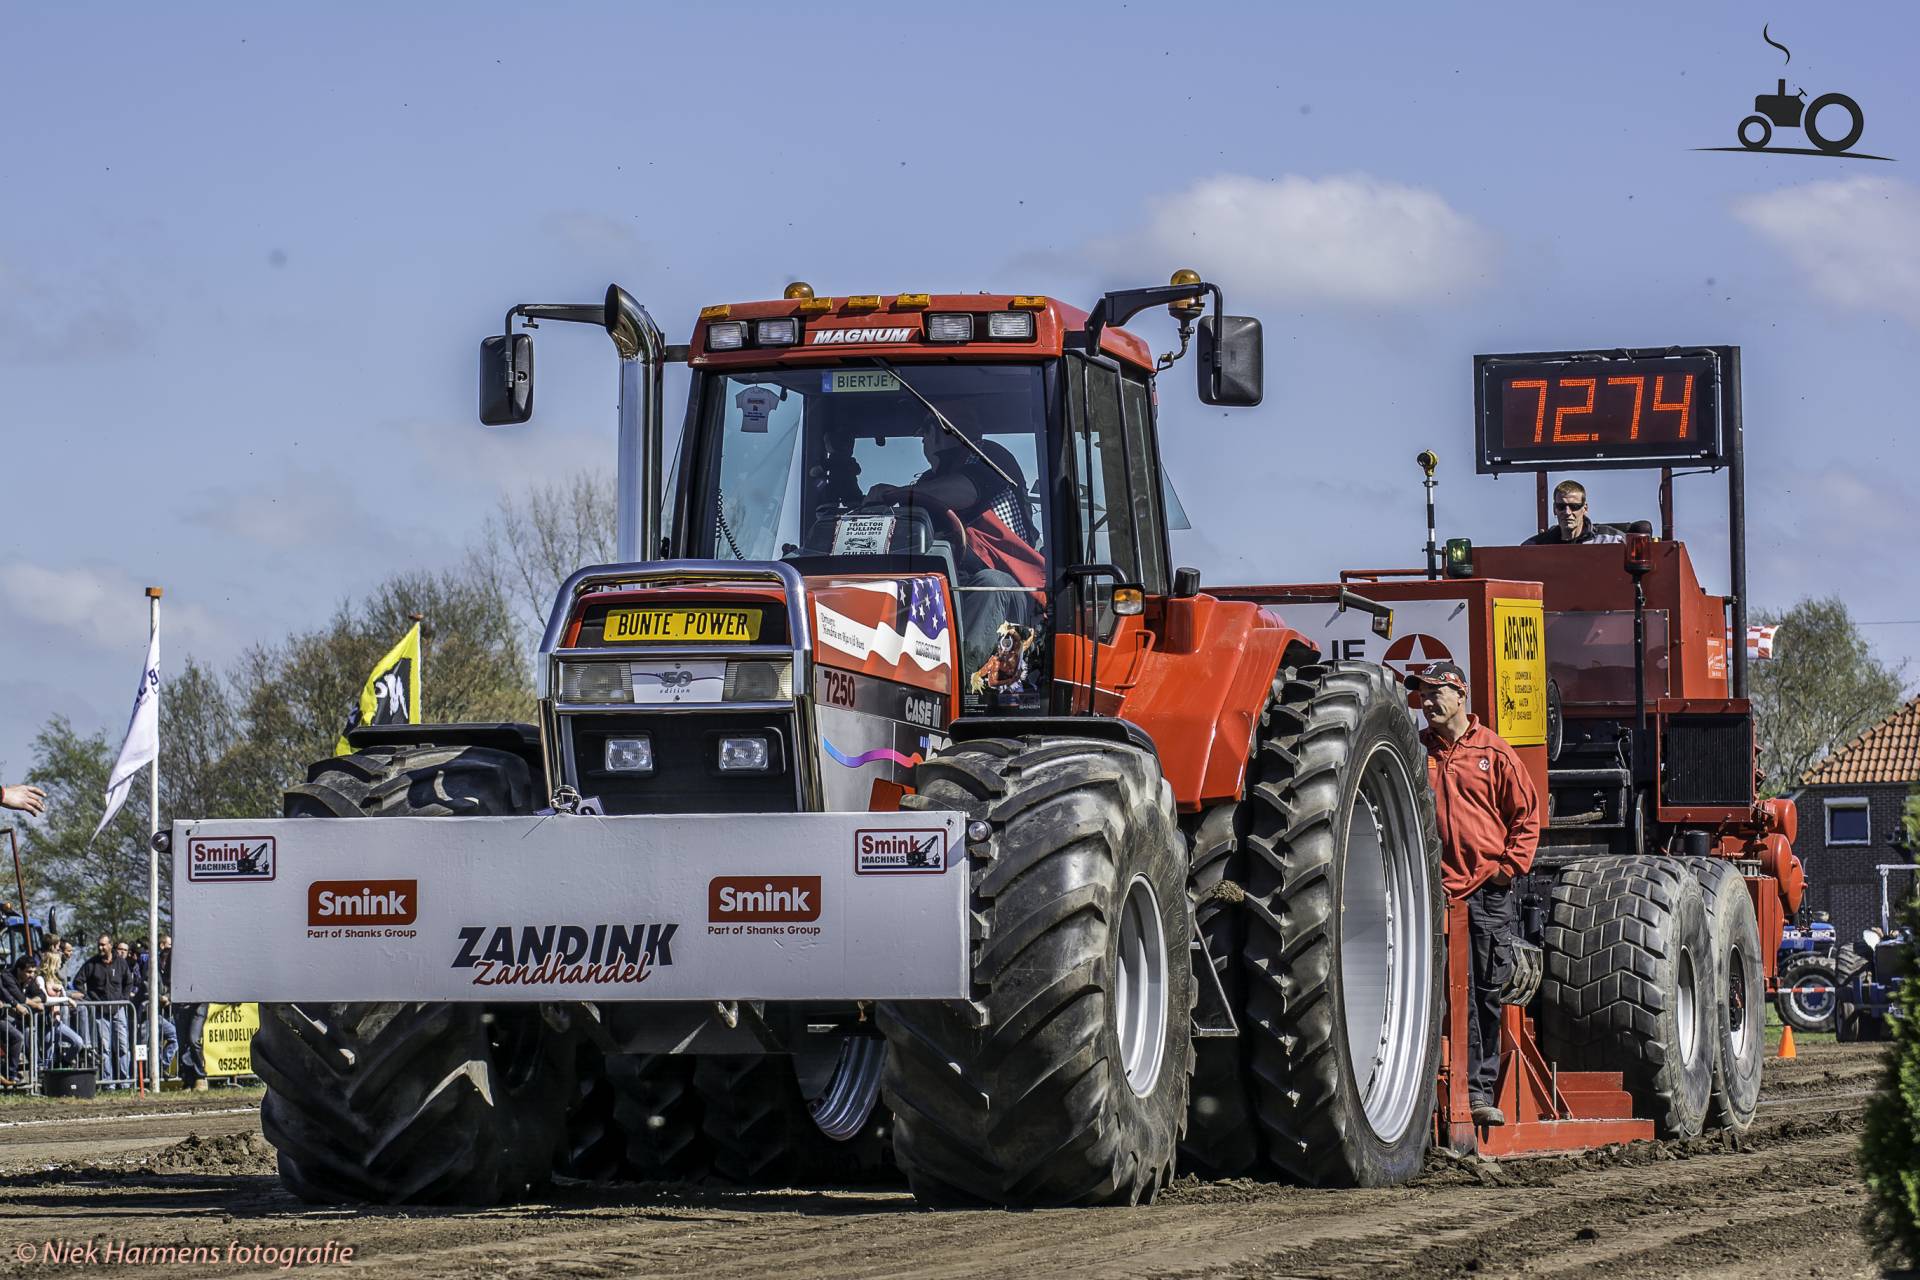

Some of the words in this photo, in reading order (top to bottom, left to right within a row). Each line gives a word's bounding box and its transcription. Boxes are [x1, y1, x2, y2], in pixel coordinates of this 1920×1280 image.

[813, 328, 911, 344] MAGNUM
[837, 374, 895, 388] BIERTJE?
[1511, 375, 1693, 443] 72.74
[617, 613, 674, 636] BUNTE
[684, 613, 748, 635] POWER
[1504, 616, 1539, 660] ARENTSEN
[824, 671, 856, 708] 7250
[905, 696, 933, 726] CASE
[194, 843, 251, 862] Smink
[861, 835, 920, 854] Smink
[194, 863, 237, 872] MACHINES
[861, 855, 906, 864] MACHINES
[318, 887, 408, 916] Smink
[718, 883, 811, 912] Smink
[307, 929, 330, 939] Part
[332, 929, 342, 938] of
[345, 929, 382, 938] Shanks
[385, 928, 417, 940] Group
[707, 926, 730, 935] Part
[732, 926, 743, 935] of
[746, 926, 784, 935] Shanks
[787, 926, 821, 936] Group
[450, 923, 680, 968] ZANDINK
[472, 952, 652, 986] Zandhandel
